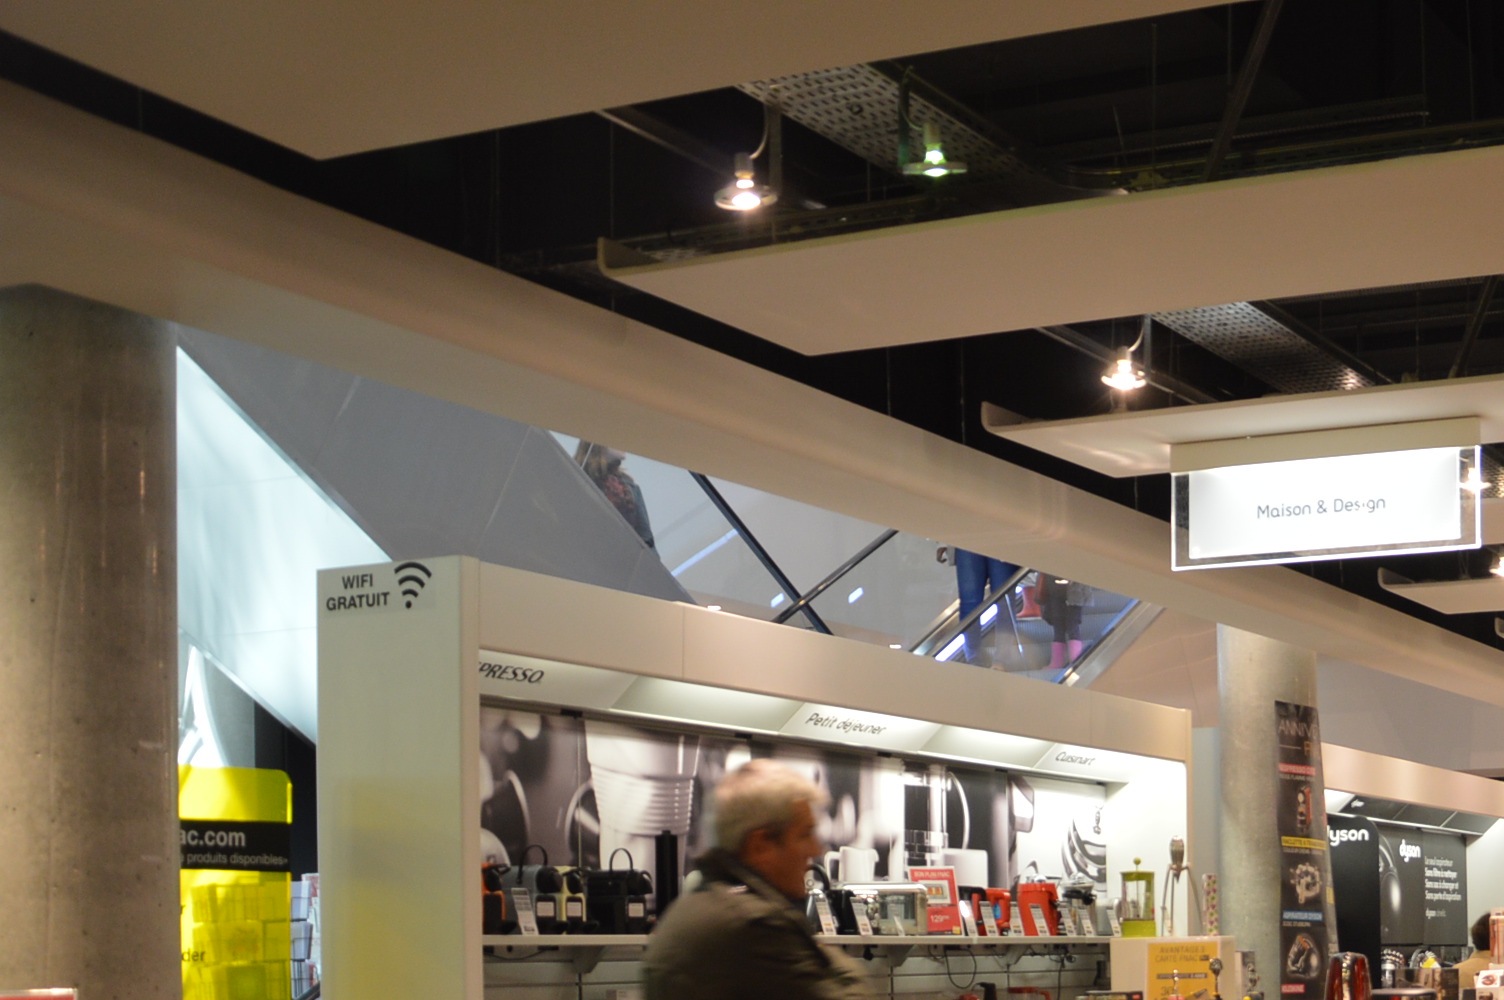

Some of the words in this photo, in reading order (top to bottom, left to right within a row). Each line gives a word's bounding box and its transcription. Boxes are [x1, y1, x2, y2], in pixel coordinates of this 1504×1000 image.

[1257, 504, 1311, 519] Maison
[1317, 500, 1327, 514] &
[342, 574, 374, 589] WIFI
[326, 592, 390, 611] GRATUIT
[479, 662, 544, 684] PRESSO
[805, 712, 837, 728] Petit
[1055, 750, 1097, 766] Cuisinart
[187, 852, 227, 865] produits
[1400, 839, 1421, 862] dyson
